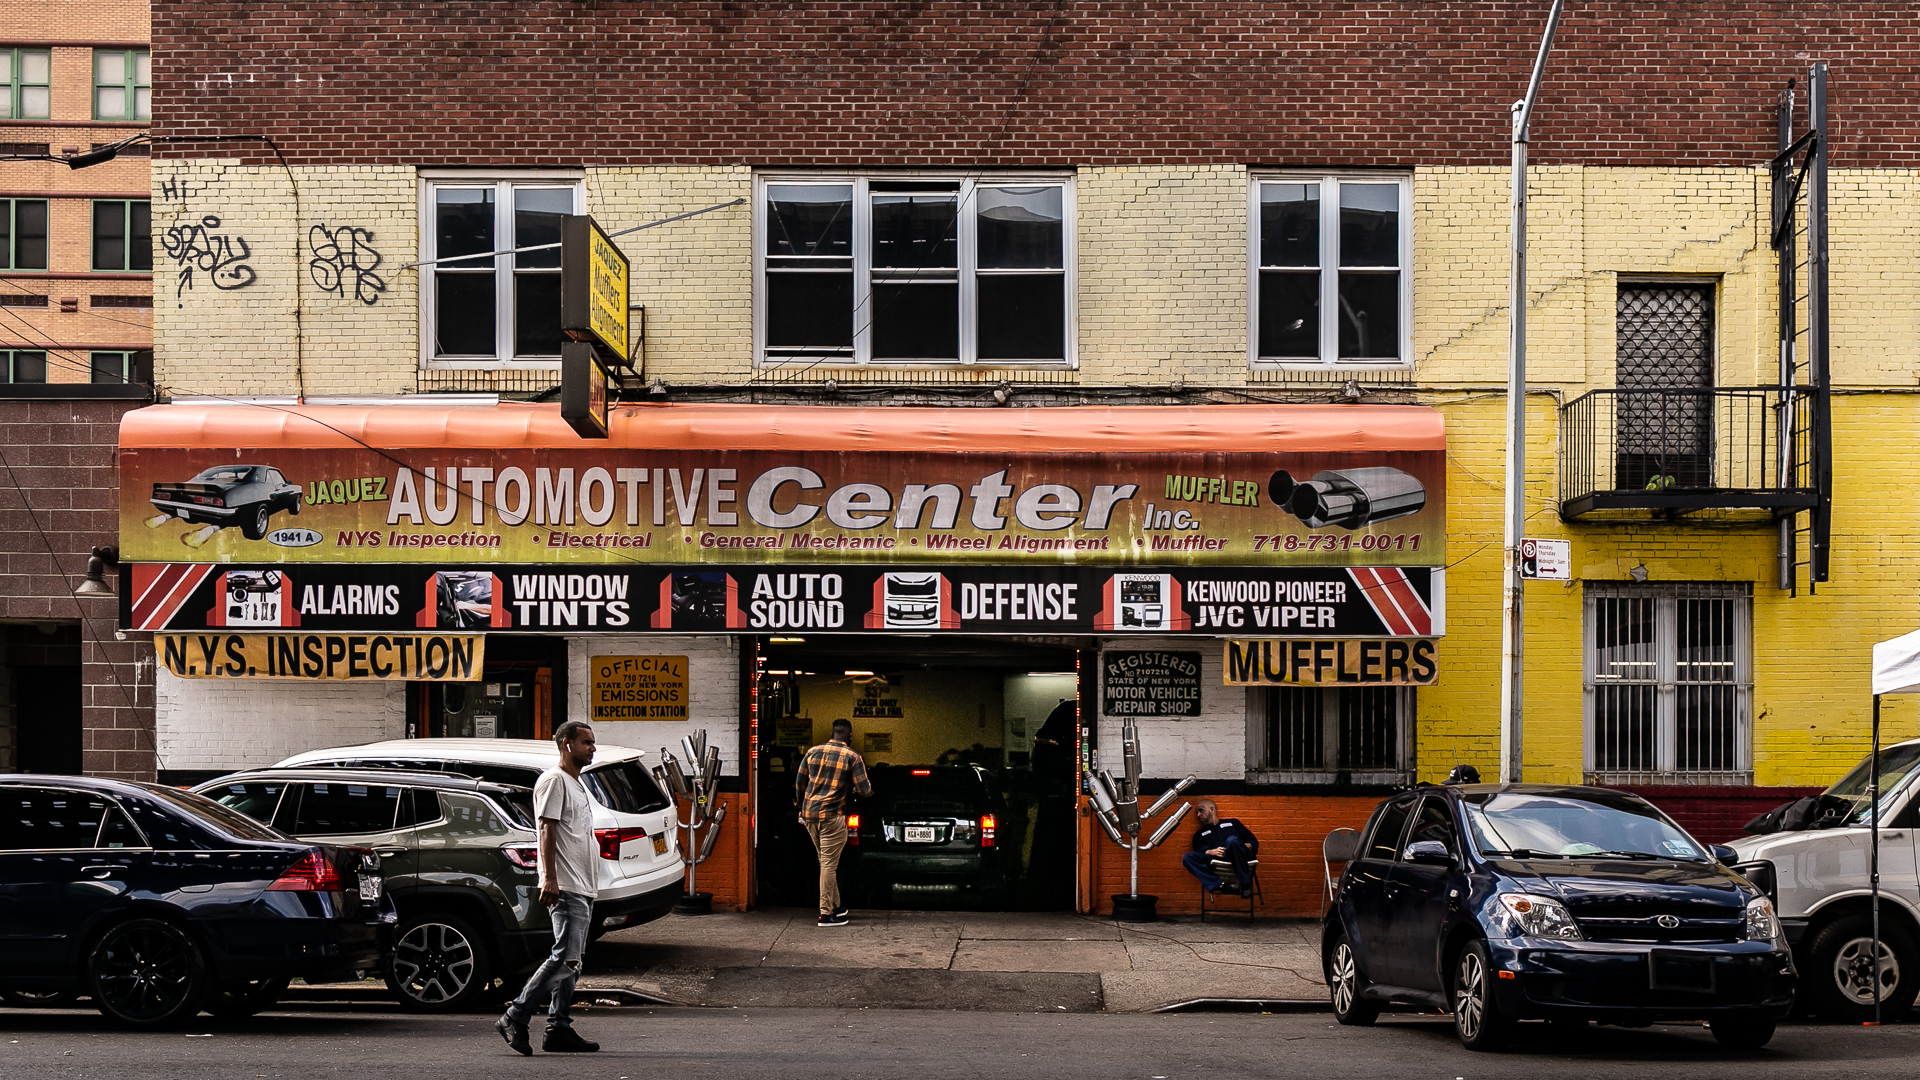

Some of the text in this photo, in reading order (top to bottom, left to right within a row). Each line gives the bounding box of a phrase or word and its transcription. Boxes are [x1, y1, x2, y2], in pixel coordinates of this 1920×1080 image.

[594, 238, 622, 282] JAQUEZ
[592, 262, 620, 313] Mufflers
[591, 292, 624, 347] Alignment
[304, 477, 388, 505] JAQUEZ
[386, 466, 1139, 530] AUTOMOTIVE Center
[1164, 474, 1259, 507] MUFFLER
[1143, 505, 1199, 531] Inc.
[273, 531, 314, 544] 1941 A
[336, 530, 502, 549] NYS Inspection
[546, 530, 652, 548] Electrical
[700, 531, 897, 550] General Mechanic
[925, 531, 1111, 552] Wheel Alignment
[1152, 531, 1229, 551] Muffler
[1253, 532, 1422, 552] 718-731-0011
[512, 574, 629, 600] WINDOW
[751, 573, 843, 599] AUTO
[1187, 580, 1347, 604] KENWOOD PIONEER
[301, 584, 400, 616] ALARMS
[961, 582, 1078, 621] DEFENSE
[514, 599, 630, 626] TINTS
[749, 599, 845, 629] SOUND
[1194, 605, 1336, 628] JVC VIPER
[164, 634, 476, 678] N.Y.S. INSPECTION
[1108, 653, 1197, 676] REGISTERED
[1228, 641, 1437, 685] MUFFLERS
[601, 659, 681, 679] OFFICIAL
[1136, 668, 1170, 676] 7107216
[1108, 677, 1135, 685] STATE
[1137, 677, 1149, 685] OF
[1173, 677, 1197, 685] YORK
[601, 690, 679, 702] EMISSIONS
[1107, 687, 1198, 699] MOTOR VEHICLE
[594, 705, 686, 718] INSPECTION STATION
[854, 707, 902, 715] PASS OR FAIL
[1115, 701, 1191, 714] REPAIR SHOP
